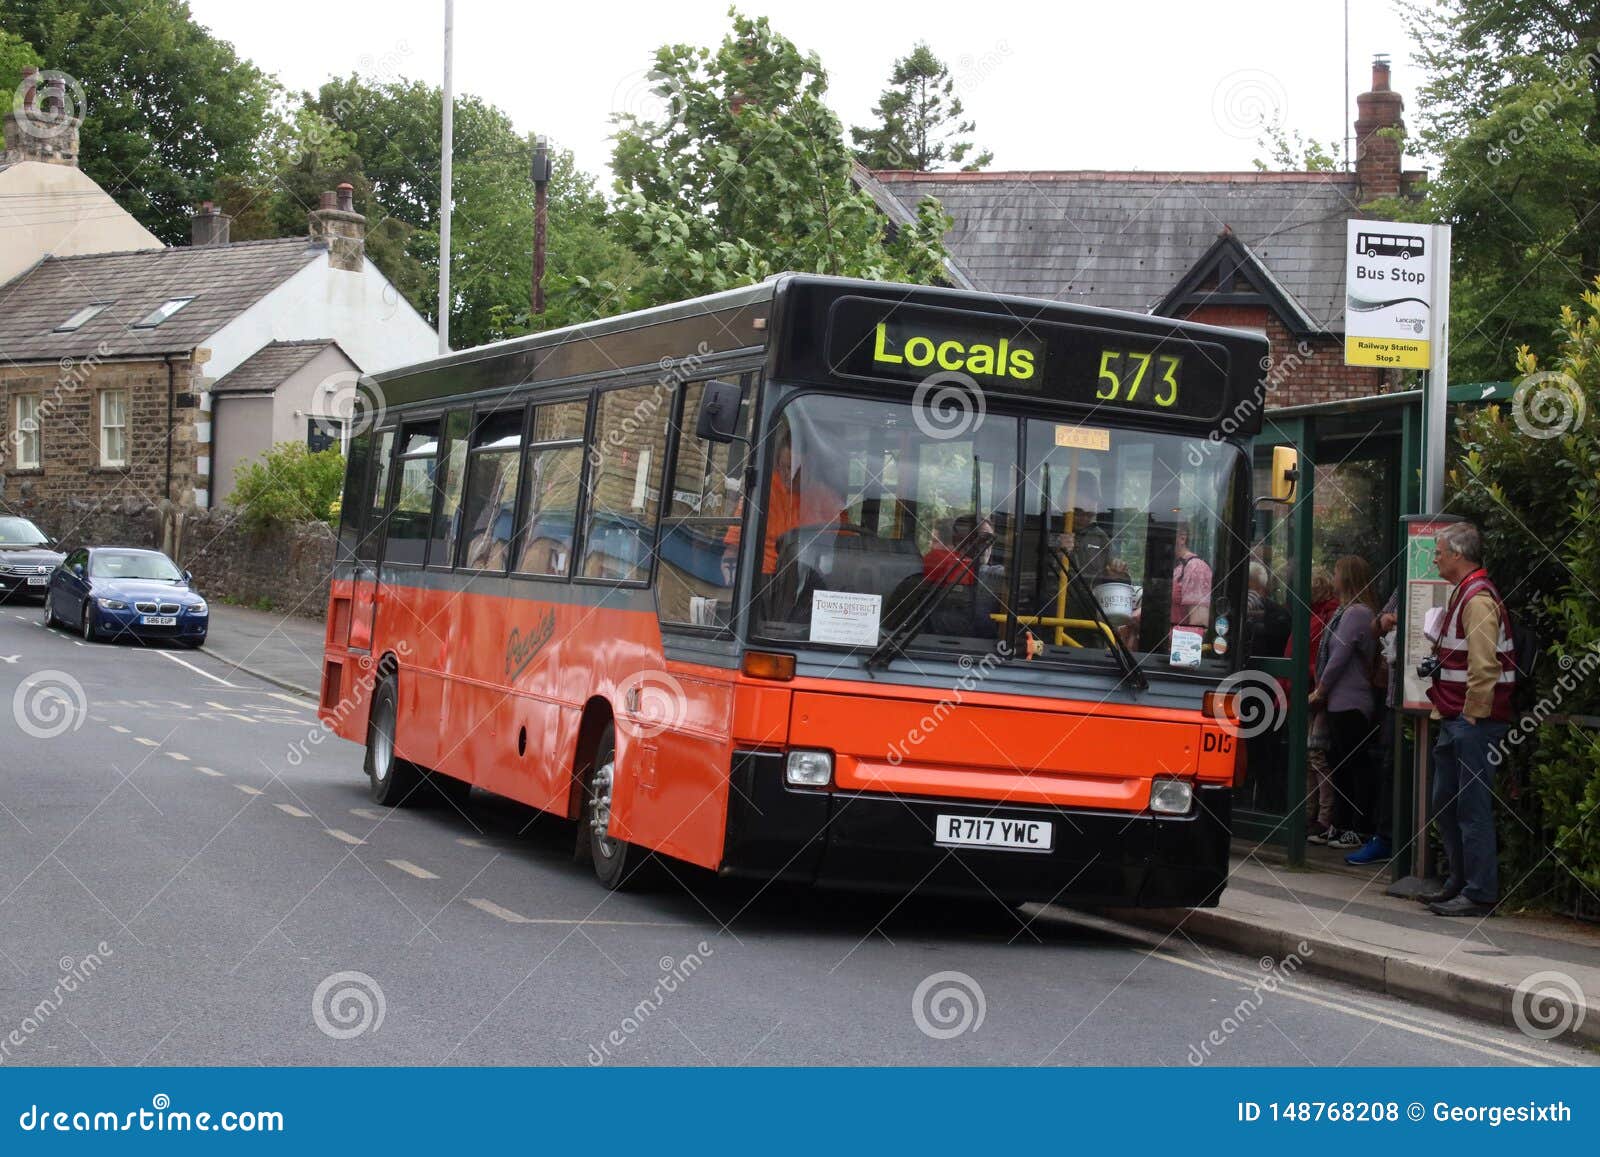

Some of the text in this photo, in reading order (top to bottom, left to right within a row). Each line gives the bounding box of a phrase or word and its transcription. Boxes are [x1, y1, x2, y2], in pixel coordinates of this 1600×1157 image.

[1356, 266, 1425, 285] Bus Stop
[1358, 341, 1418, 352] Railway Station
[873, 322, 1183, 407] Locals 573
[1376, 354, 1393, 363] Stop
[948, 818, 1040, 843] R717 YWC
